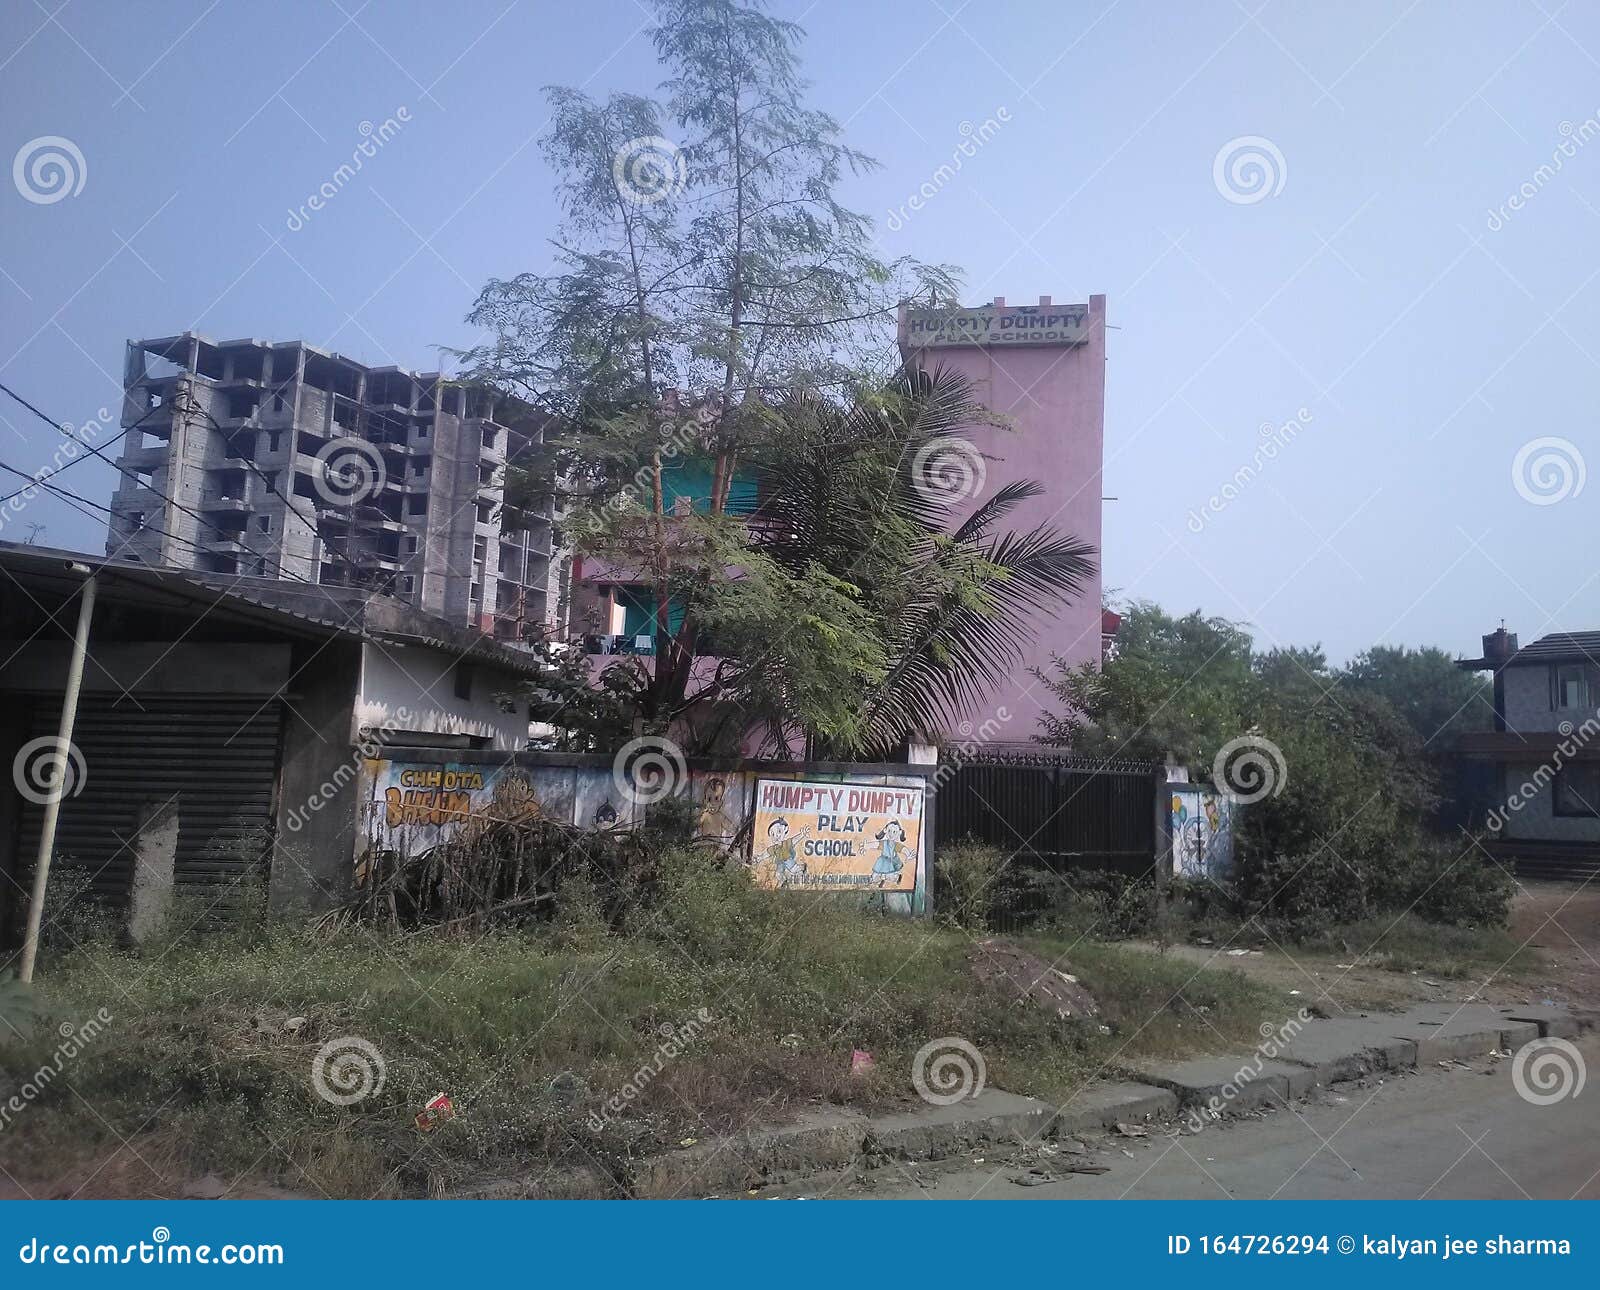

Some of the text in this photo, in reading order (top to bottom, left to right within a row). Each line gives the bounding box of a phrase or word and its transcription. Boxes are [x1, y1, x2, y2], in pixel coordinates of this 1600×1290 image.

[1000, 313, 1085, 329] DUMPTY
[989, 331, 1070, 341] SCHOOL
[400, 770, 484, 790] CHHOTA
[762, 785, 917, 815] HUMPTY DUMPTY
[817, 814, 869, 833] PLAY
[803, 839, 856, 857] SCHOOL
